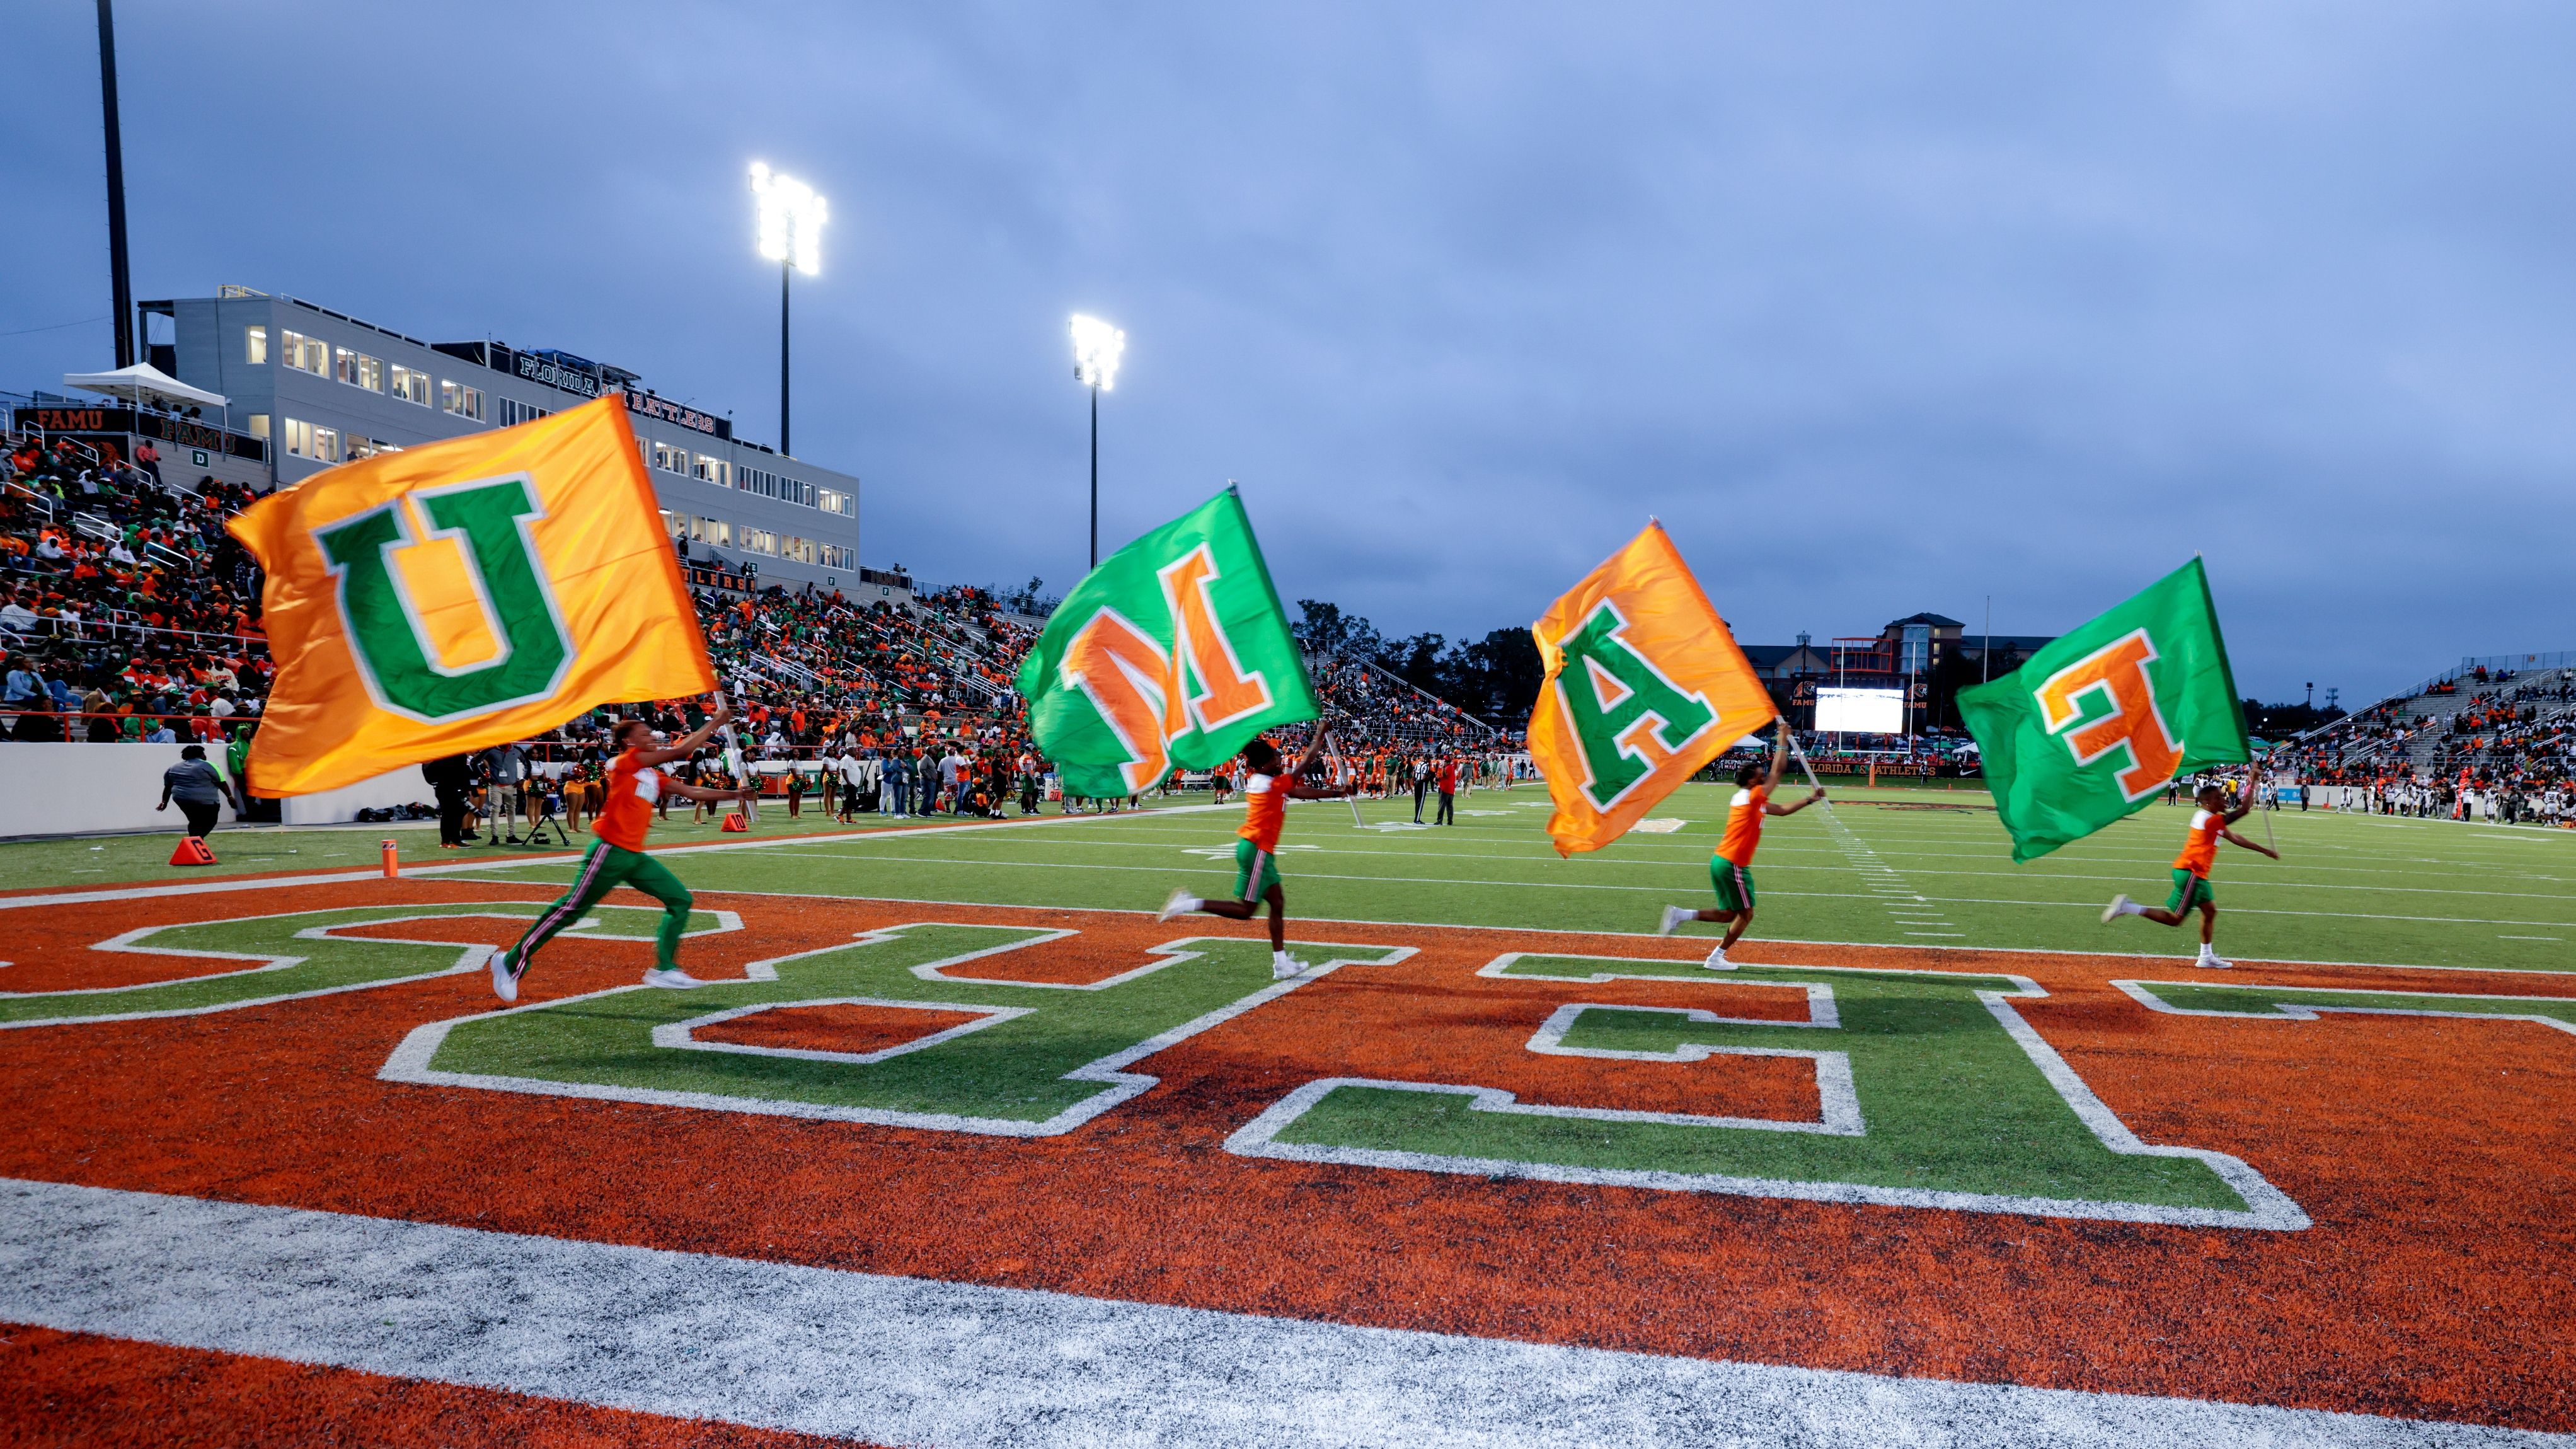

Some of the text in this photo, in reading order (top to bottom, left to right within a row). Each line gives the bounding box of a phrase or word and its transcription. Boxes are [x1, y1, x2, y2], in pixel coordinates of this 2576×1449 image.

[520, 356, 597, 398] FLORIDA
[37, 410, 103, 429] FAMU
[160, 419, 236, 453] FAMU
[196, 453, 205, 463] D
[308, 471, 577, 725] U
[1057, 541, 1275, 796] M
[1555, 596, 1721, 814] A
[731, 814, 746, 829] 10
[191, 840, 212, 860] G
